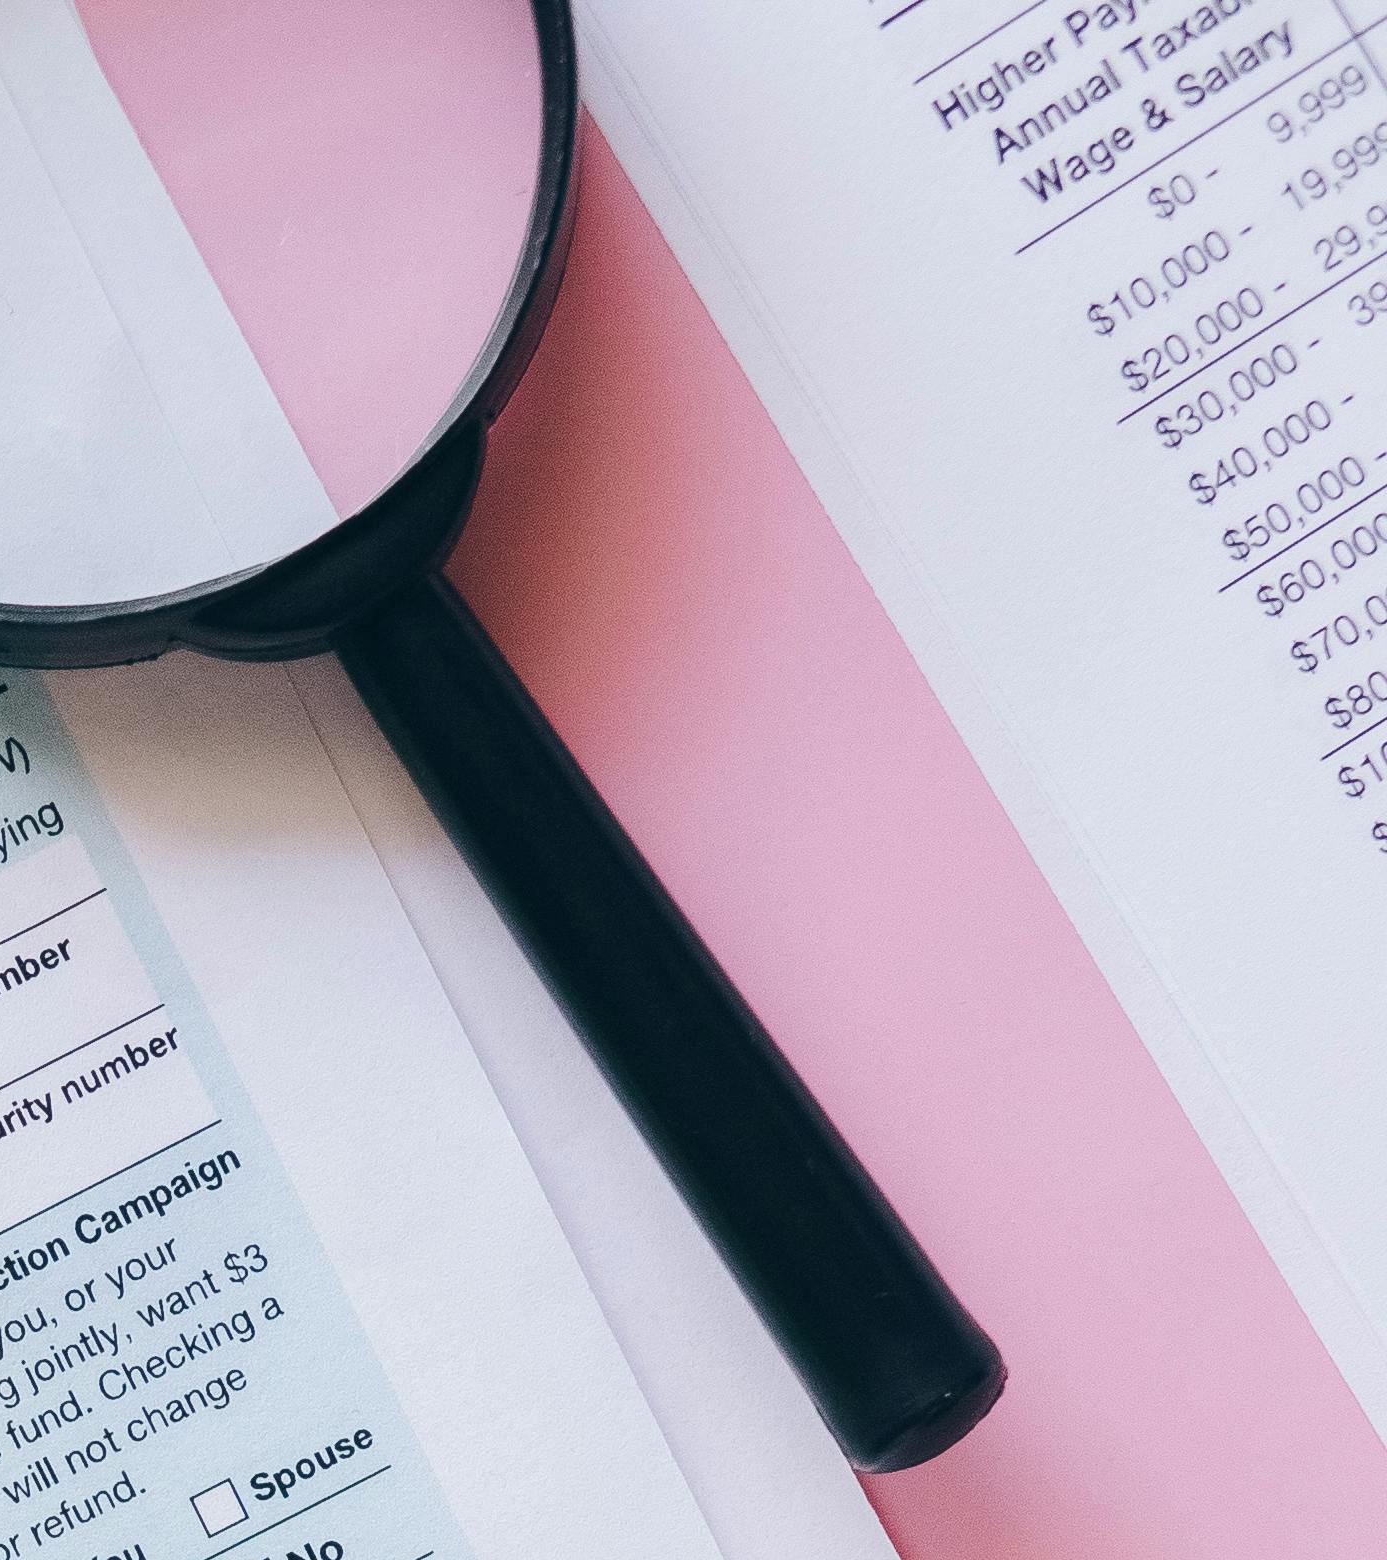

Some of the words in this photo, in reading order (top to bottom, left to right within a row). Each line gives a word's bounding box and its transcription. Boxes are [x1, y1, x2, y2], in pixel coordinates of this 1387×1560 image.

[930, 35, 1059, 133] Higher
[991, 57, 1124, 167] Annual
[1018, 125, 1136, 205] Wage
[1139, 96, 1176, 134] &
[1173, 17, 1295, 109] Salary
[1146, 172, 1198, 222] $0
[1265, 63, 1371, 145] 9,999
[1085, 228, 1232, 339] $10,000
[1119, 285, 1266, 394] $20,000
[1187, 398, 1334, 508] $40,000
[1220, 454, 1368, 563] $50,000
[73, 1148, 243, 1246] Campaign
[63, 1277, 98, 1314] or
[103, 1236, 178, 1302] your
[248, 1427, 375, 1502] Spouse
